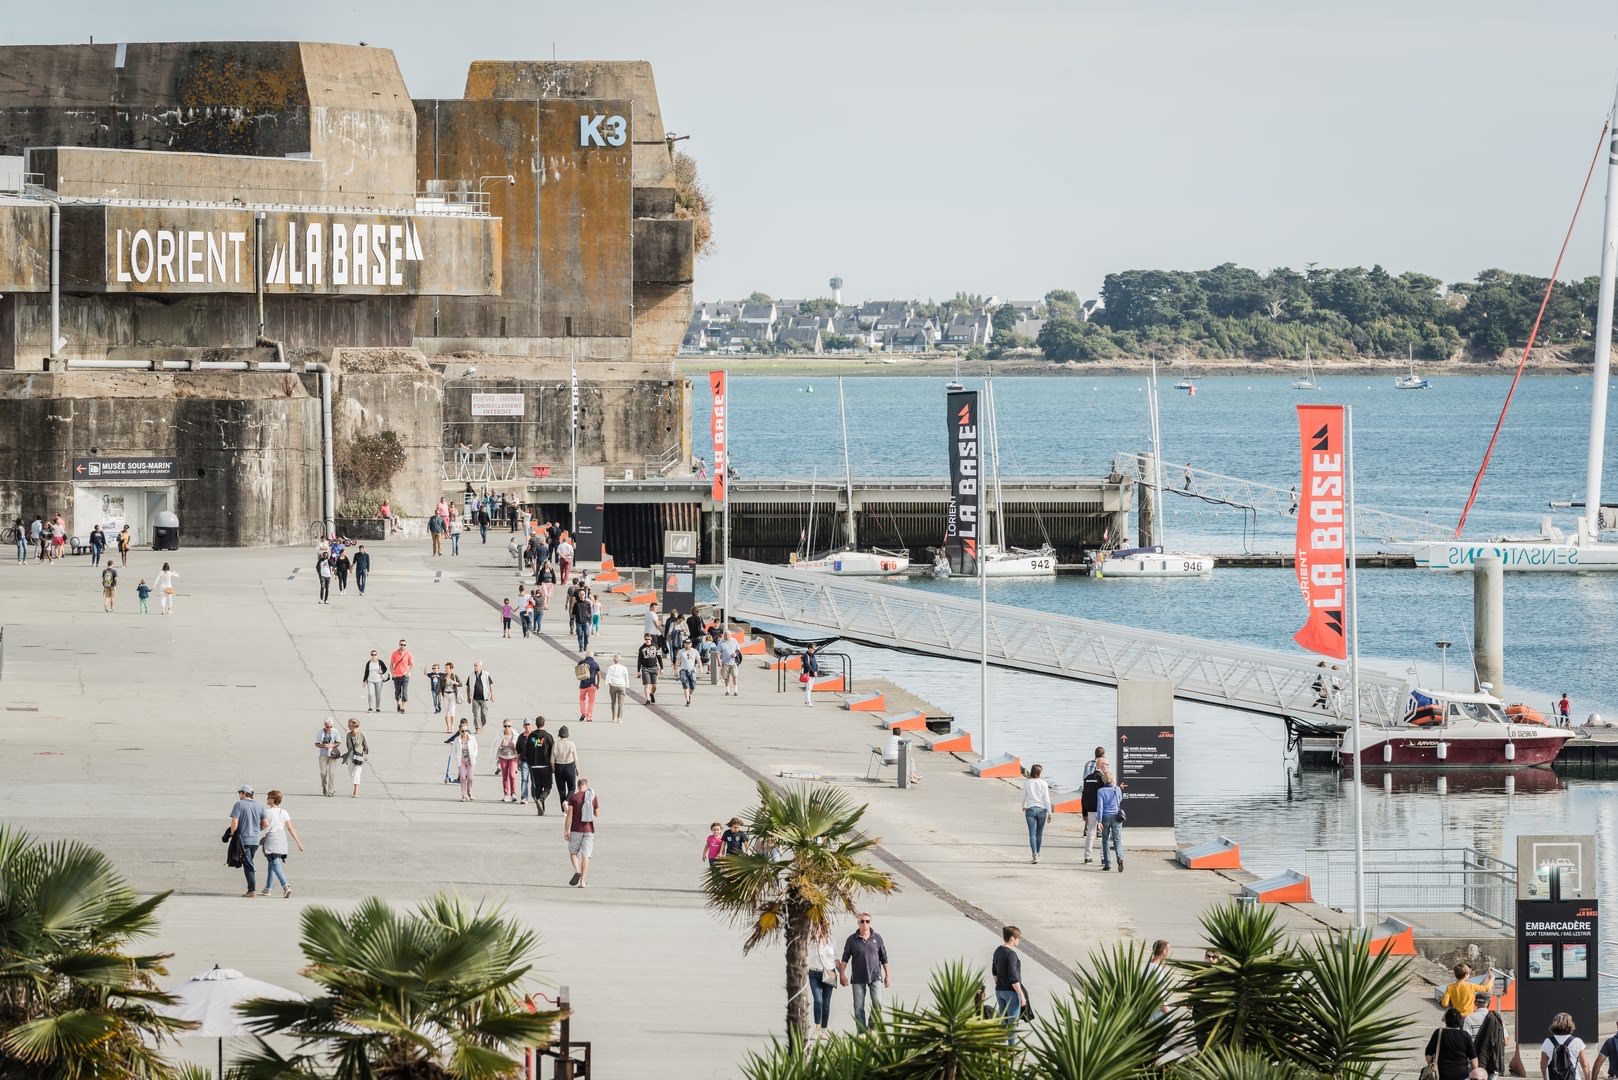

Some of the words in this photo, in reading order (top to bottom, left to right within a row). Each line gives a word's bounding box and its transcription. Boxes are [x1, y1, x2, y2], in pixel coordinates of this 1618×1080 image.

[579, 115, 627, 147] K3
[116, 228, 246, 283] LORIENT
[289, 221, 322, 285] LA
[332, 223, 403, 286] BASE
[101, 461, 126, 470] MUSÉE
[127, 462, 171, 470] SOUS-MARIN
[958, 424, 977, 496] BASE
[947, 495, 957, 537] LORIENT
[1310, 453, 1343, 550] BASE
[958, 504, 977, 538] LA
[1031, 560, 1050, 570] 942
[1183, 561, 1203, 572] 946
[1311, 563, 1343, 608] LA
[1525, 921, 1592, 930] EMBARCADÈRE
